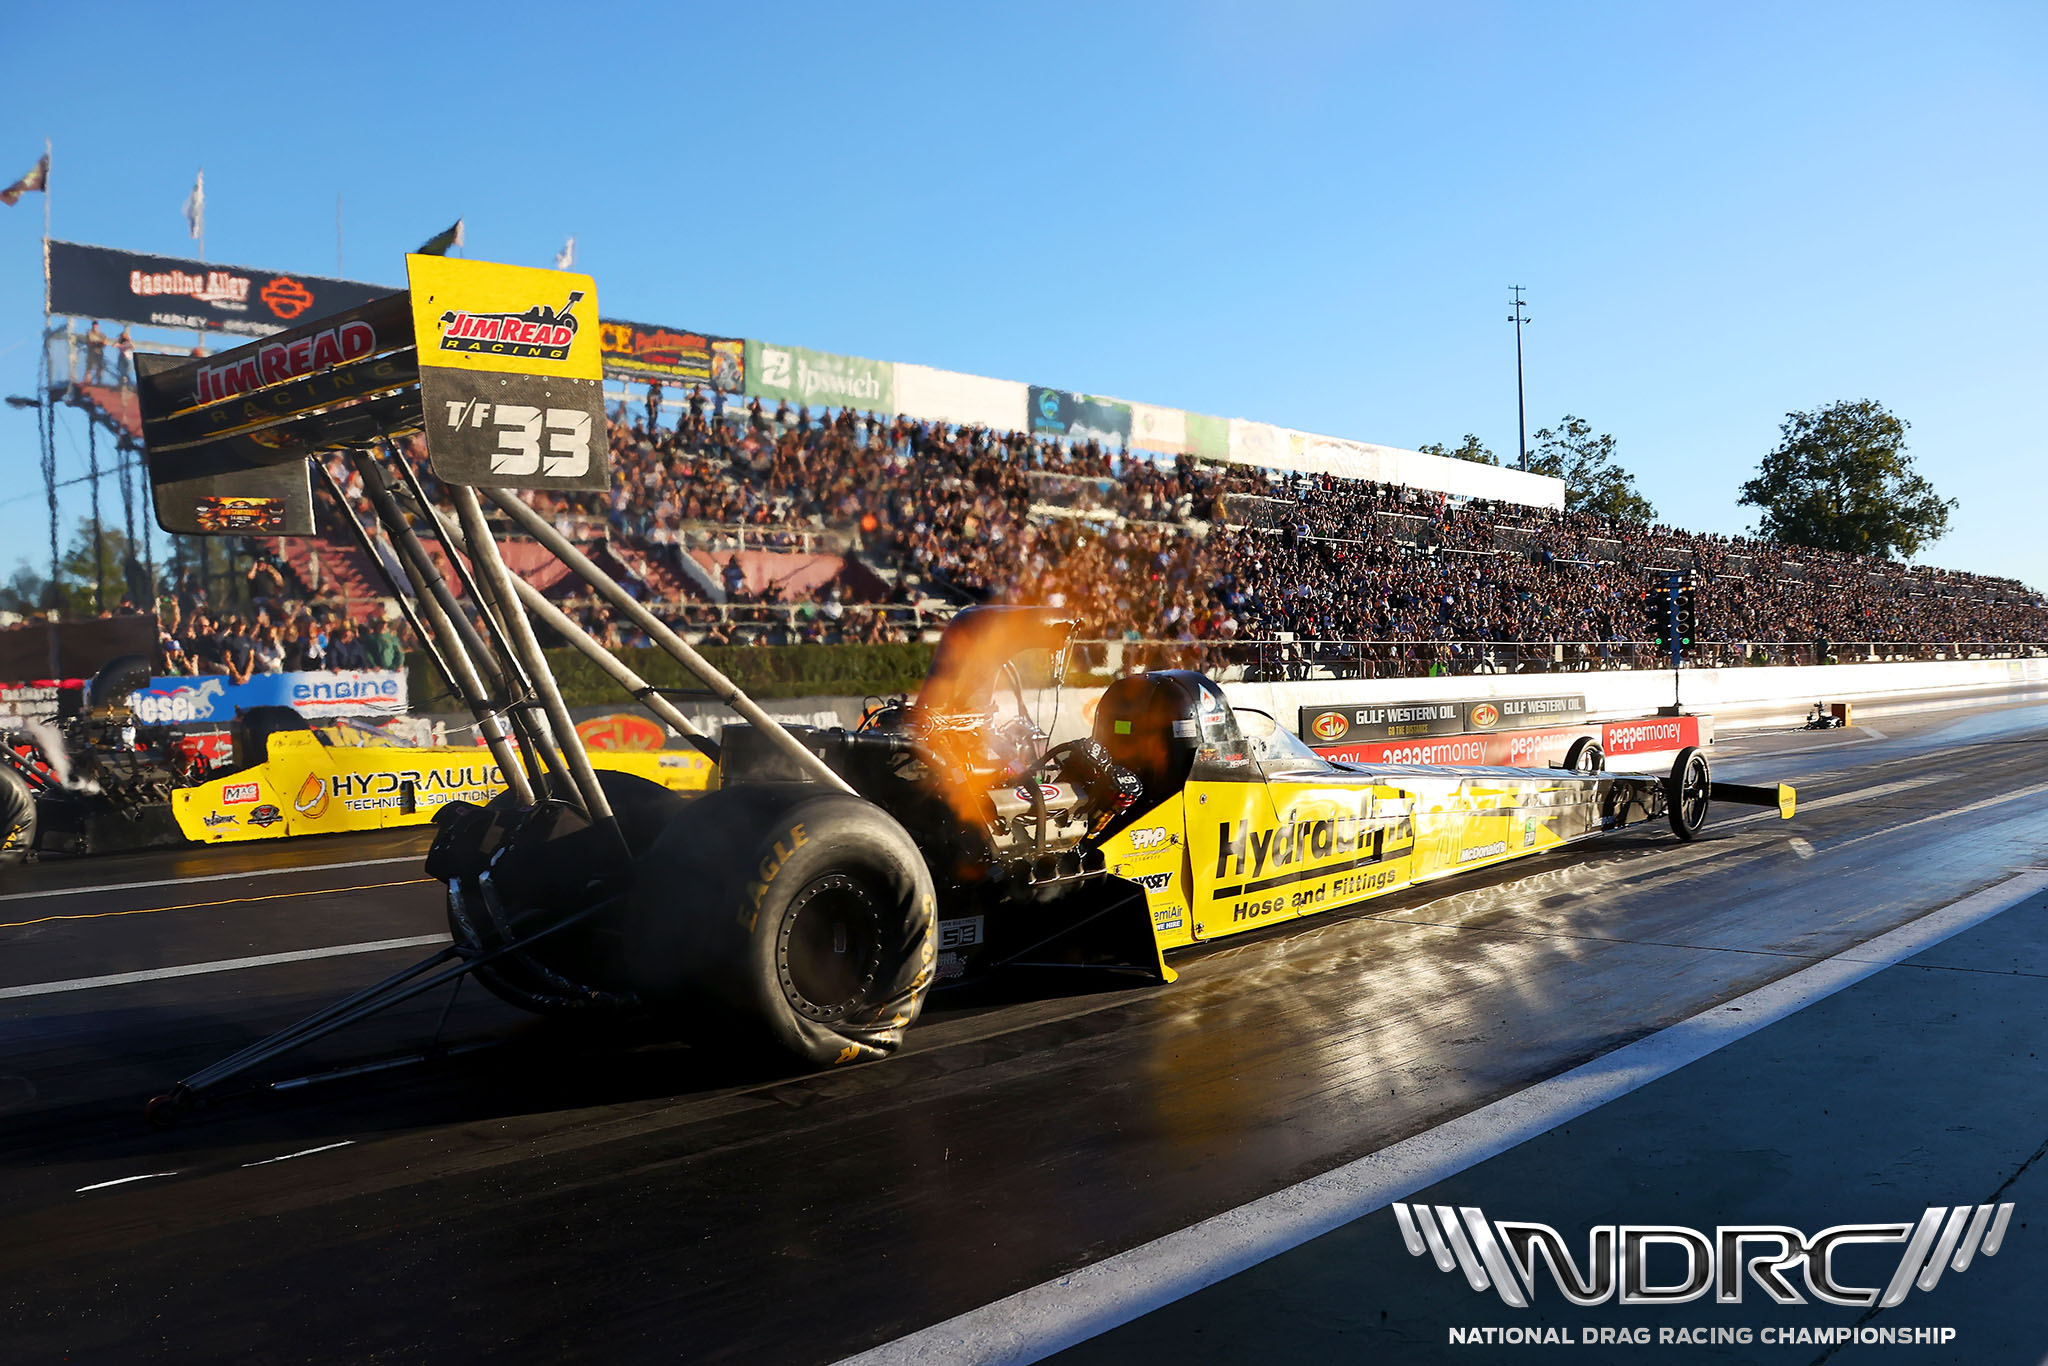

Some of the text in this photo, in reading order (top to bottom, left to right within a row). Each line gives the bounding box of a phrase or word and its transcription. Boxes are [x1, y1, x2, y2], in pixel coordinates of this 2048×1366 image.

[130, 270, 250, 298] Gasoline Alley
[445, 340, 564, 358] RACING
[210, 361, 395, 423] RACING
[797, 359, 881, 400] Ipswich
[445, 397, 592, 477] T/F 33
[292, 674, 399, 700] engine
[124, 693, 197, 722] iesel
[1356, 705, 1456, 725] GULF WESTERN OIL
[1503, 698, 1582, 715] GULF WESTERN OIL
[1609, 722, 1681, 752] peppermoney
[1117, 776, 1136, 786] MSD
[1460, 841, 1507, 863] McDonald's
[736, 823, 809, 934] EAGLE
[1234, 869, 1396, 922] Hose and Fittings
[1154, 905, 1182, 921] emiAir
[1165, 920, 1182, 930] HIRE
